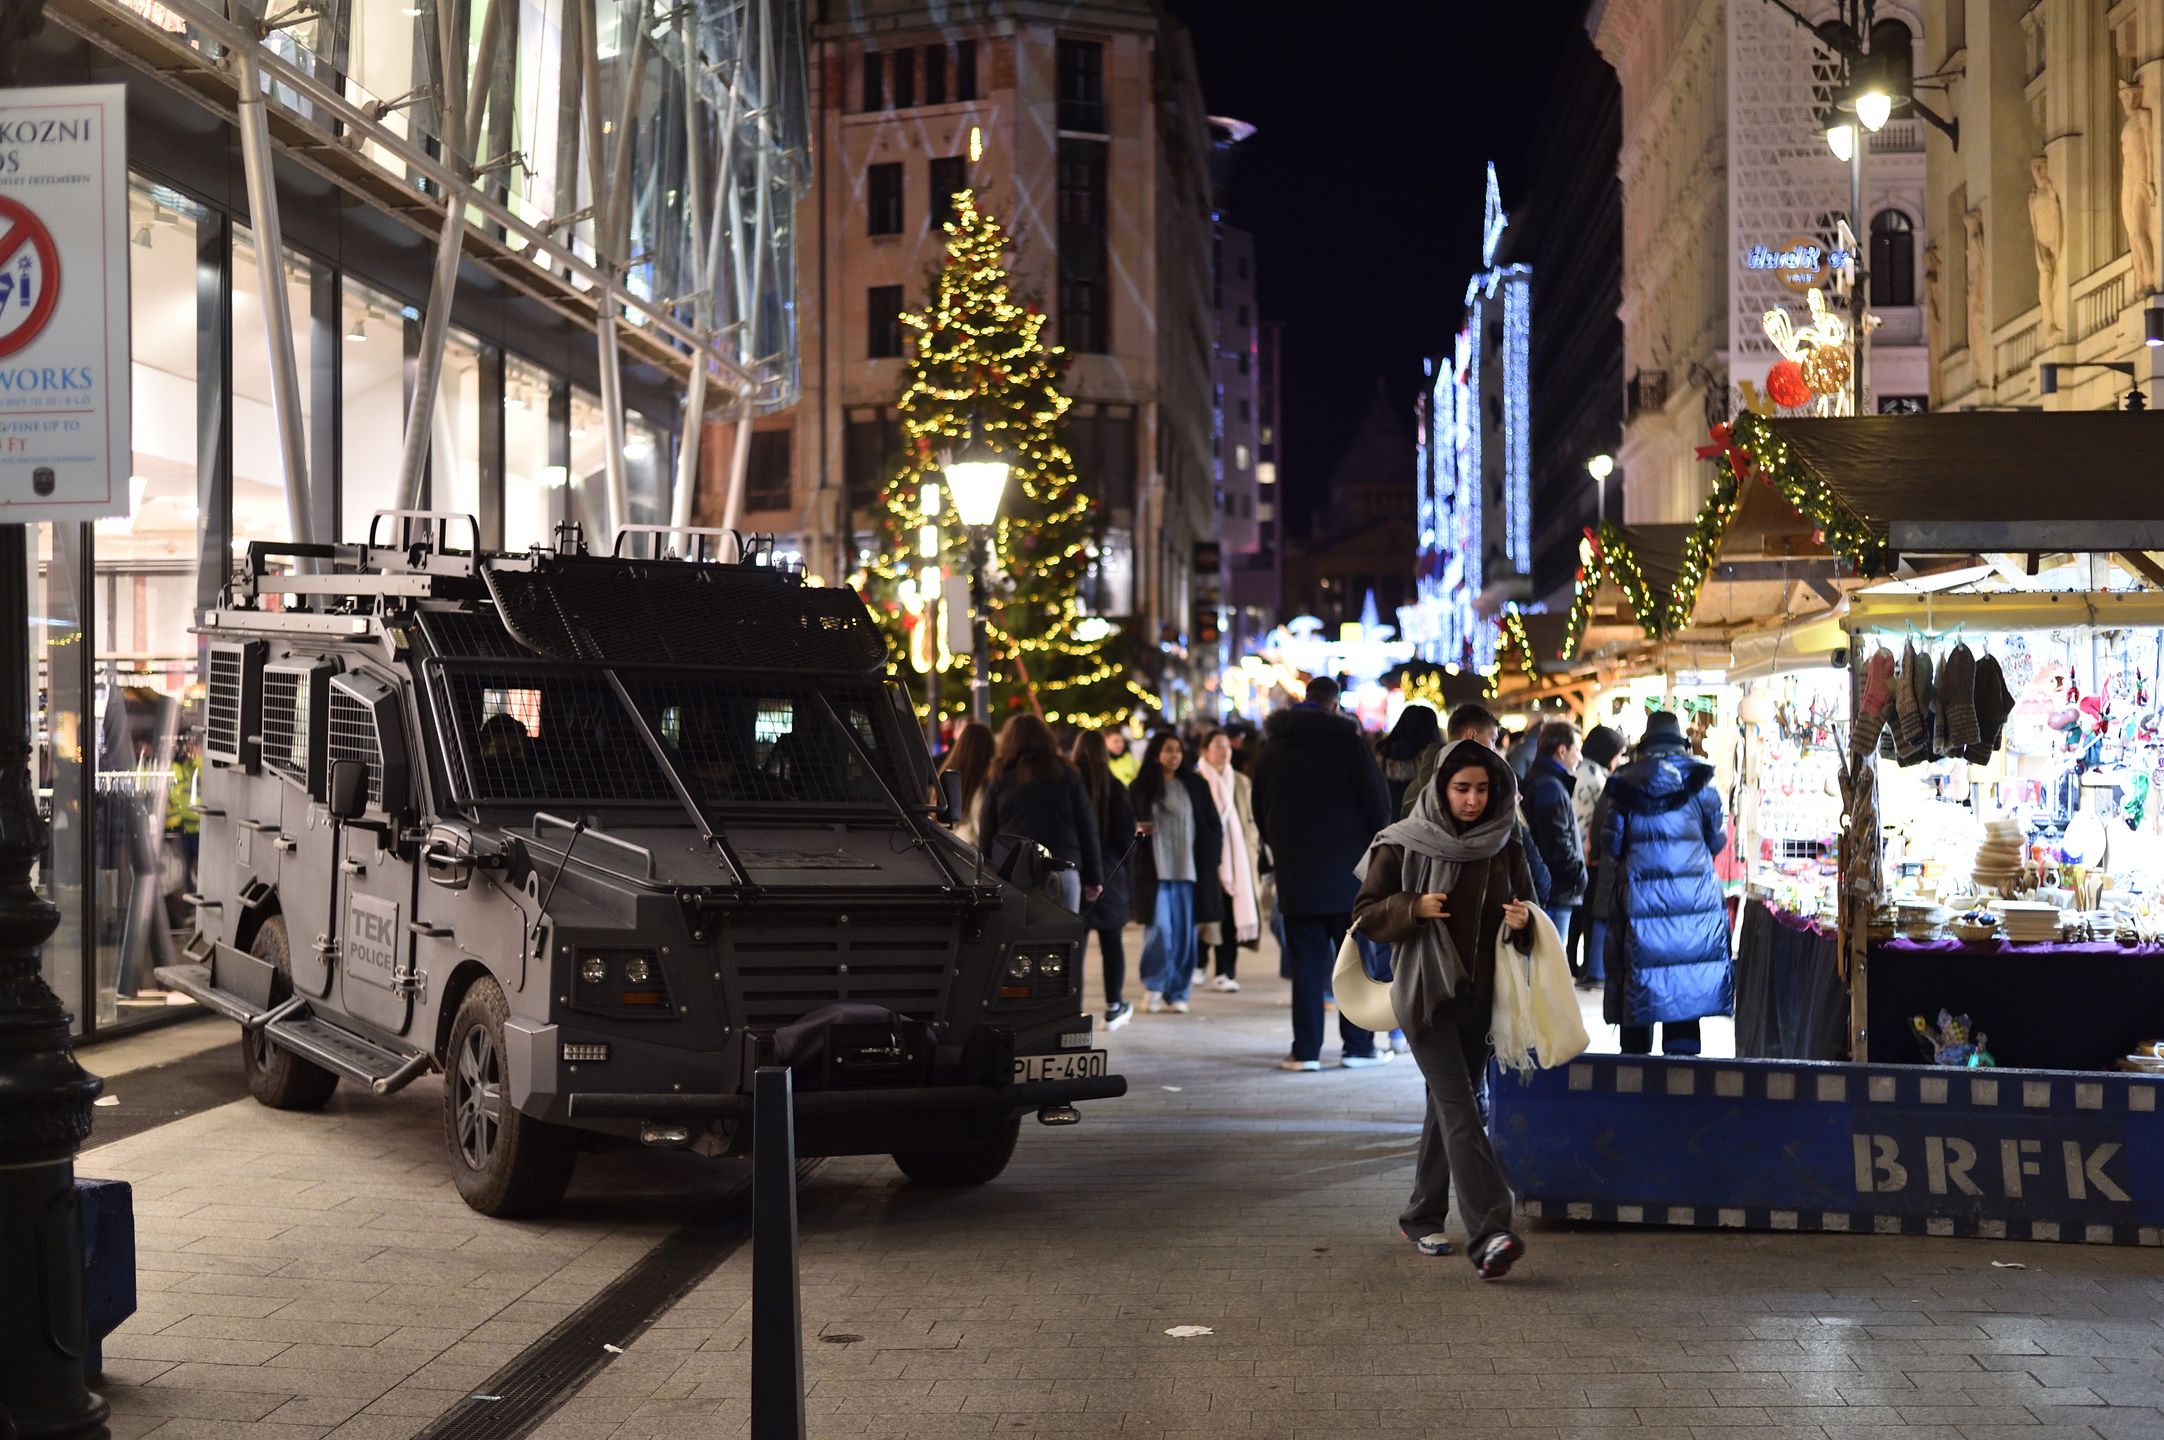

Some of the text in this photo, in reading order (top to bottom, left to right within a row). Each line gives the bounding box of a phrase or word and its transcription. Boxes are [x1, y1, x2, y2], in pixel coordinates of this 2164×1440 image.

[0, 150, 19, 173] S
[352, 907, 393, 946] TEK
[350, 941, 392, 971] POLICE
[1013, 1055, 1101, 1082] PLE-490
[1852, 1134, 2133, 1202] BRFK
